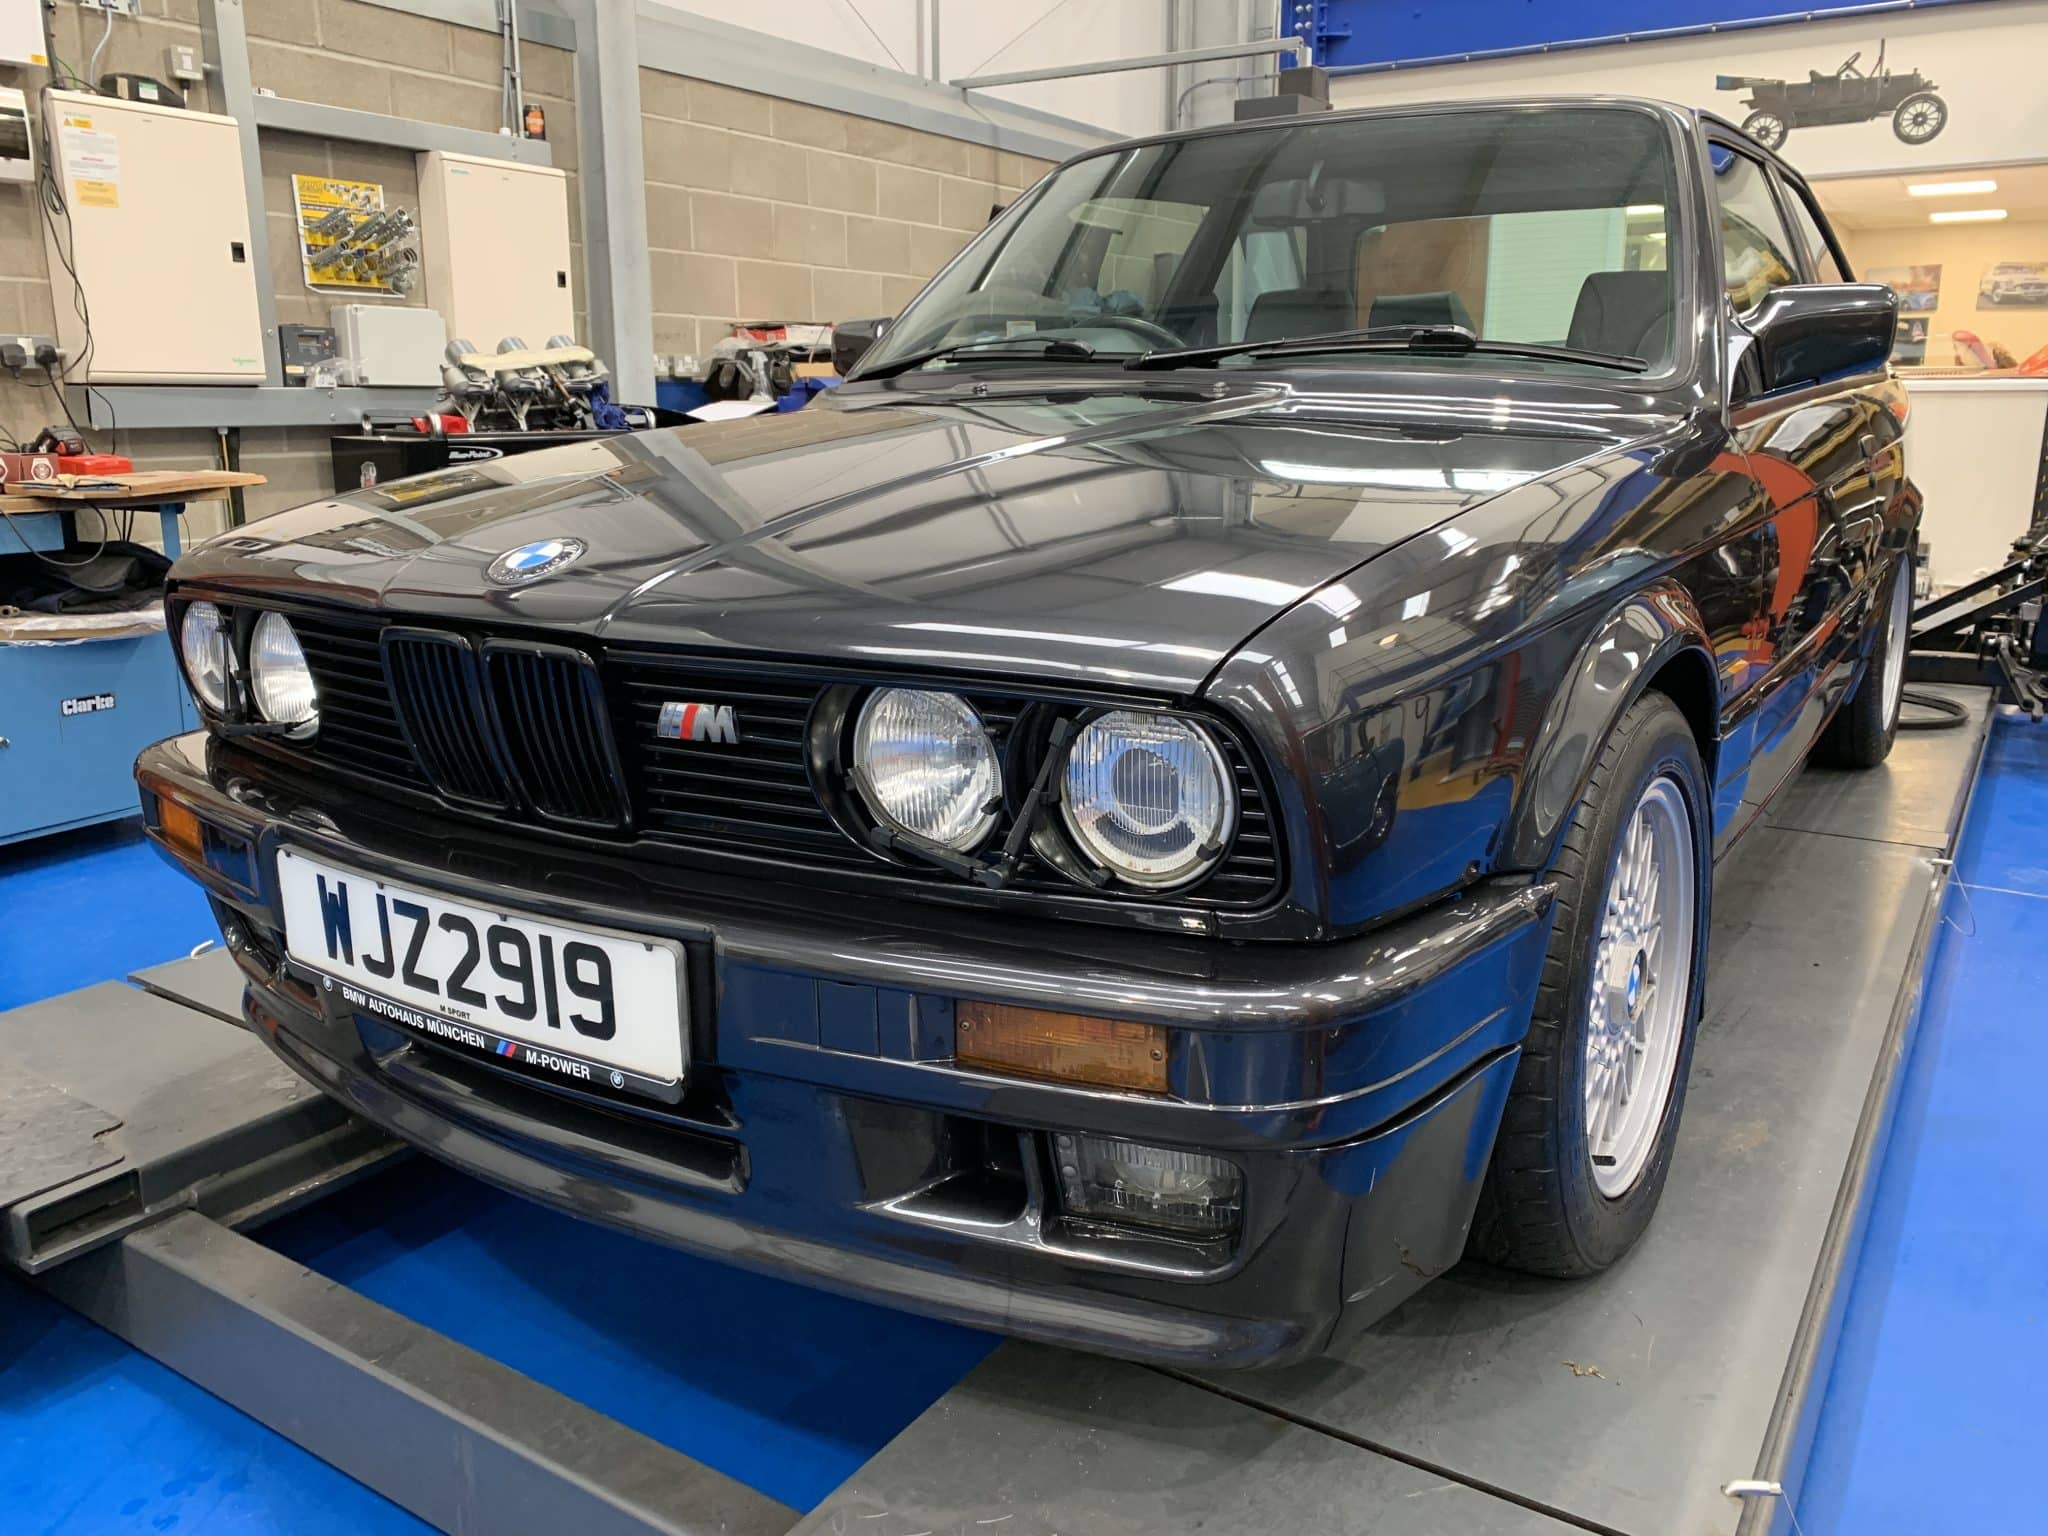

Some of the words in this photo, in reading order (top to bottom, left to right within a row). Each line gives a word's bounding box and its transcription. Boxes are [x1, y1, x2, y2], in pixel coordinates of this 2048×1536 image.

[62, 695, 114, 715] Clarke
[316, 874, 617, 1041] WJZ2919
[342, 986, 366, 1007] BMW
[368, 998, 424, 1029] AUTOHAUS
[426, 1018, 485, 1049] MÜNCHEN
[526, 1049, 591, 1080] M-POWER
[440, 1004, 447, 1012] M
[448, 1007, 471, 1020] SPORT
